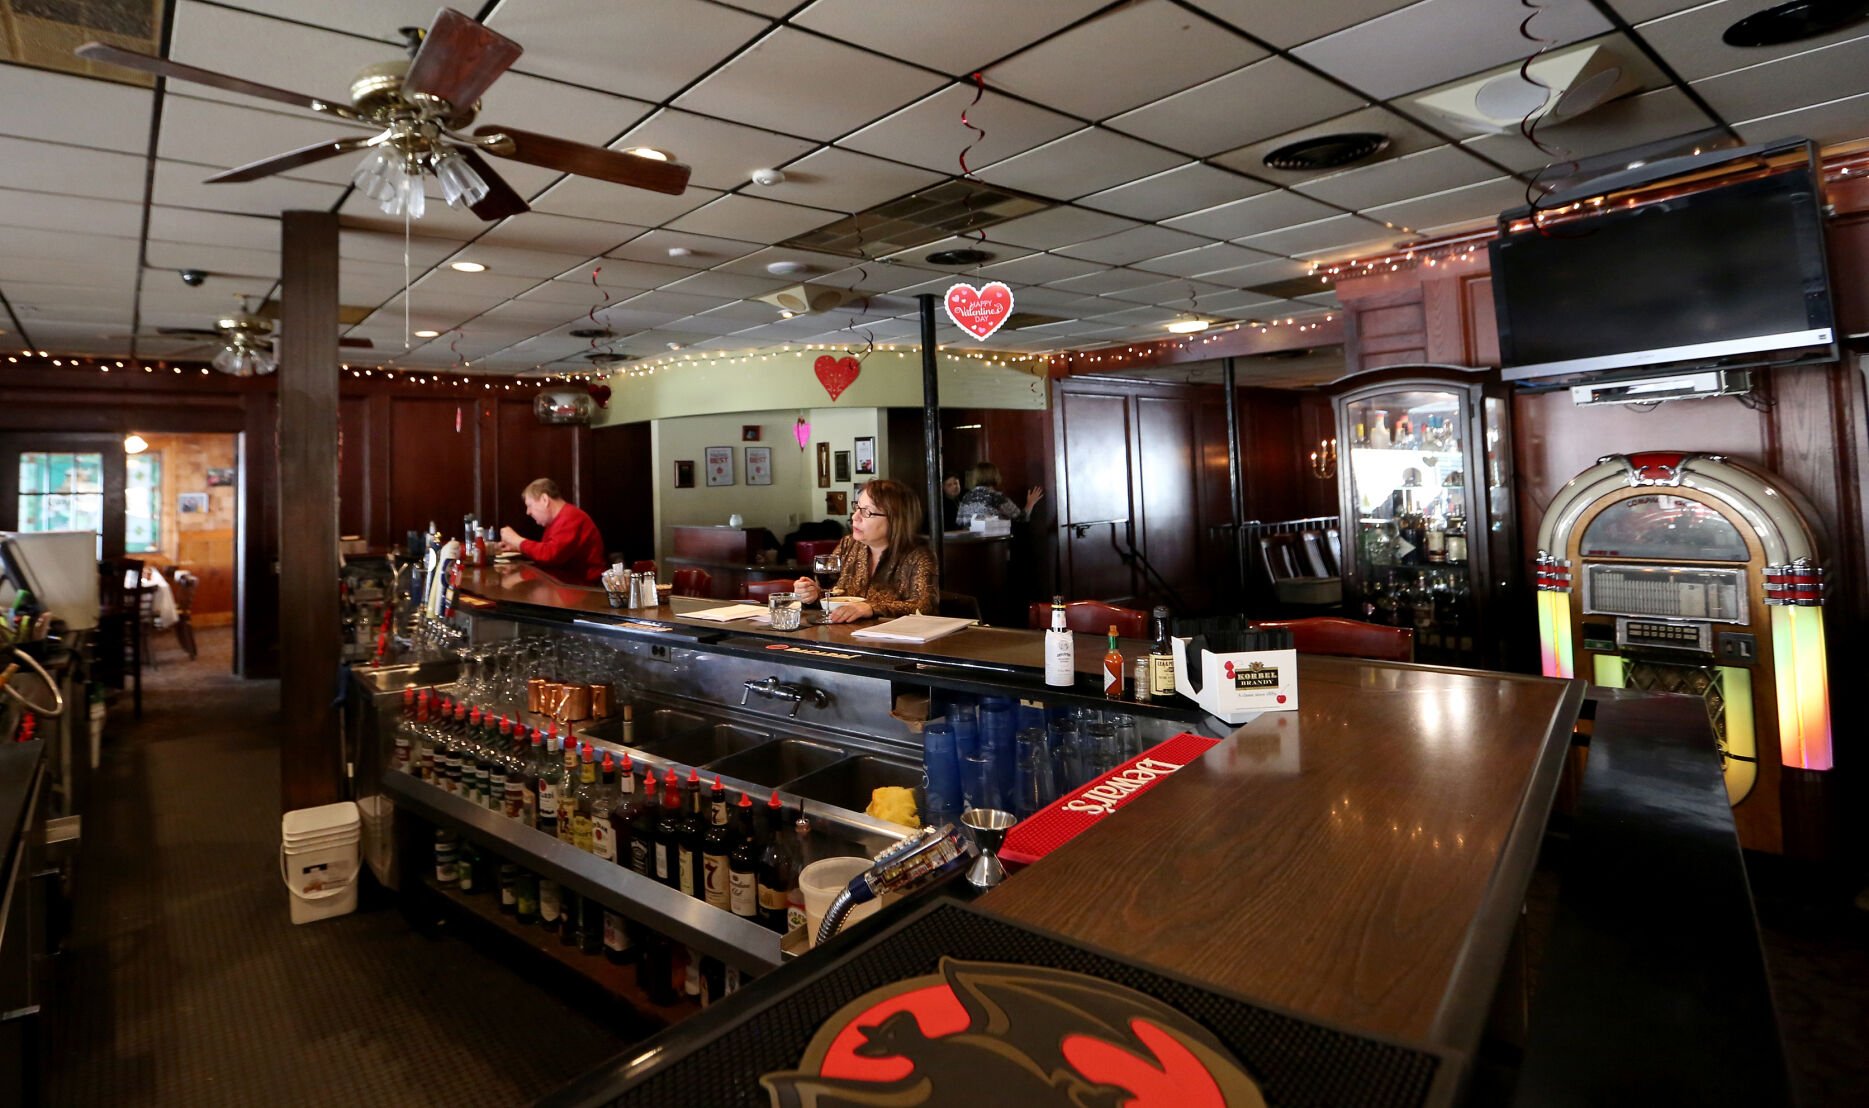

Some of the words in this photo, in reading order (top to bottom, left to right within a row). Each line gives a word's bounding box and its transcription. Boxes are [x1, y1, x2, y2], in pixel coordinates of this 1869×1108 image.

[970, 300, 993, 308] HAPPY
[975, 315, 989, 323] DAY
[1237, 672, 1278, 681] KORBEL
[1062, 757, 1184, 815] Dewar's
